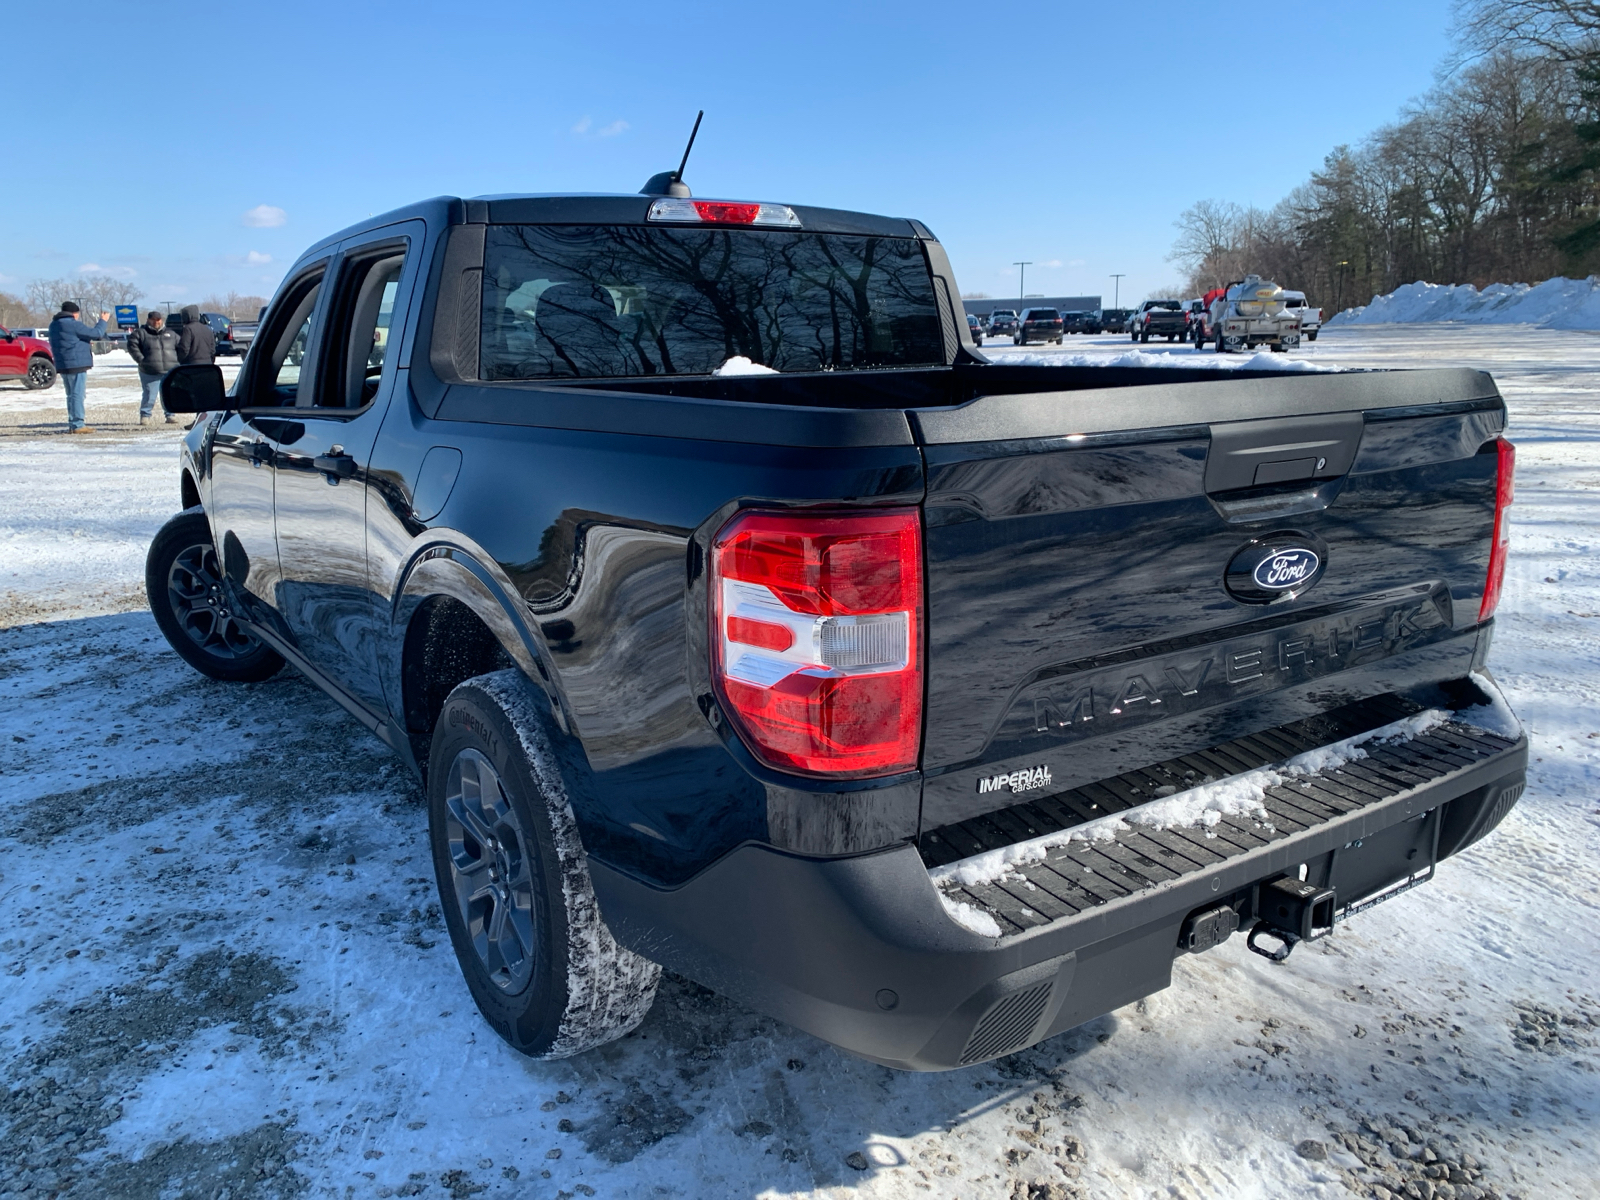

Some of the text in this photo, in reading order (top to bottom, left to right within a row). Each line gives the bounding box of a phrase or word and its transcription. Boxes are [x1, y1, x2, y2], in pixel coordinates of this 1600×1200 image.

[1267, 554, 1308, 583] Ford
[1034, 603, 1424, 731] MAVERICK
[449, 706, 492, 747] Continental
[978, 764, 1051, 793] IMPERIAL
[1012, 778, 1051, 793] cars.com
[1346, 907, 1357, 918] Sell
[1376, 897, 1384, 905] So
[1385, 891, 1397, 900] You
[1397, 885, 1410, 895] Save
[1411, 878, 1426, 888] More
